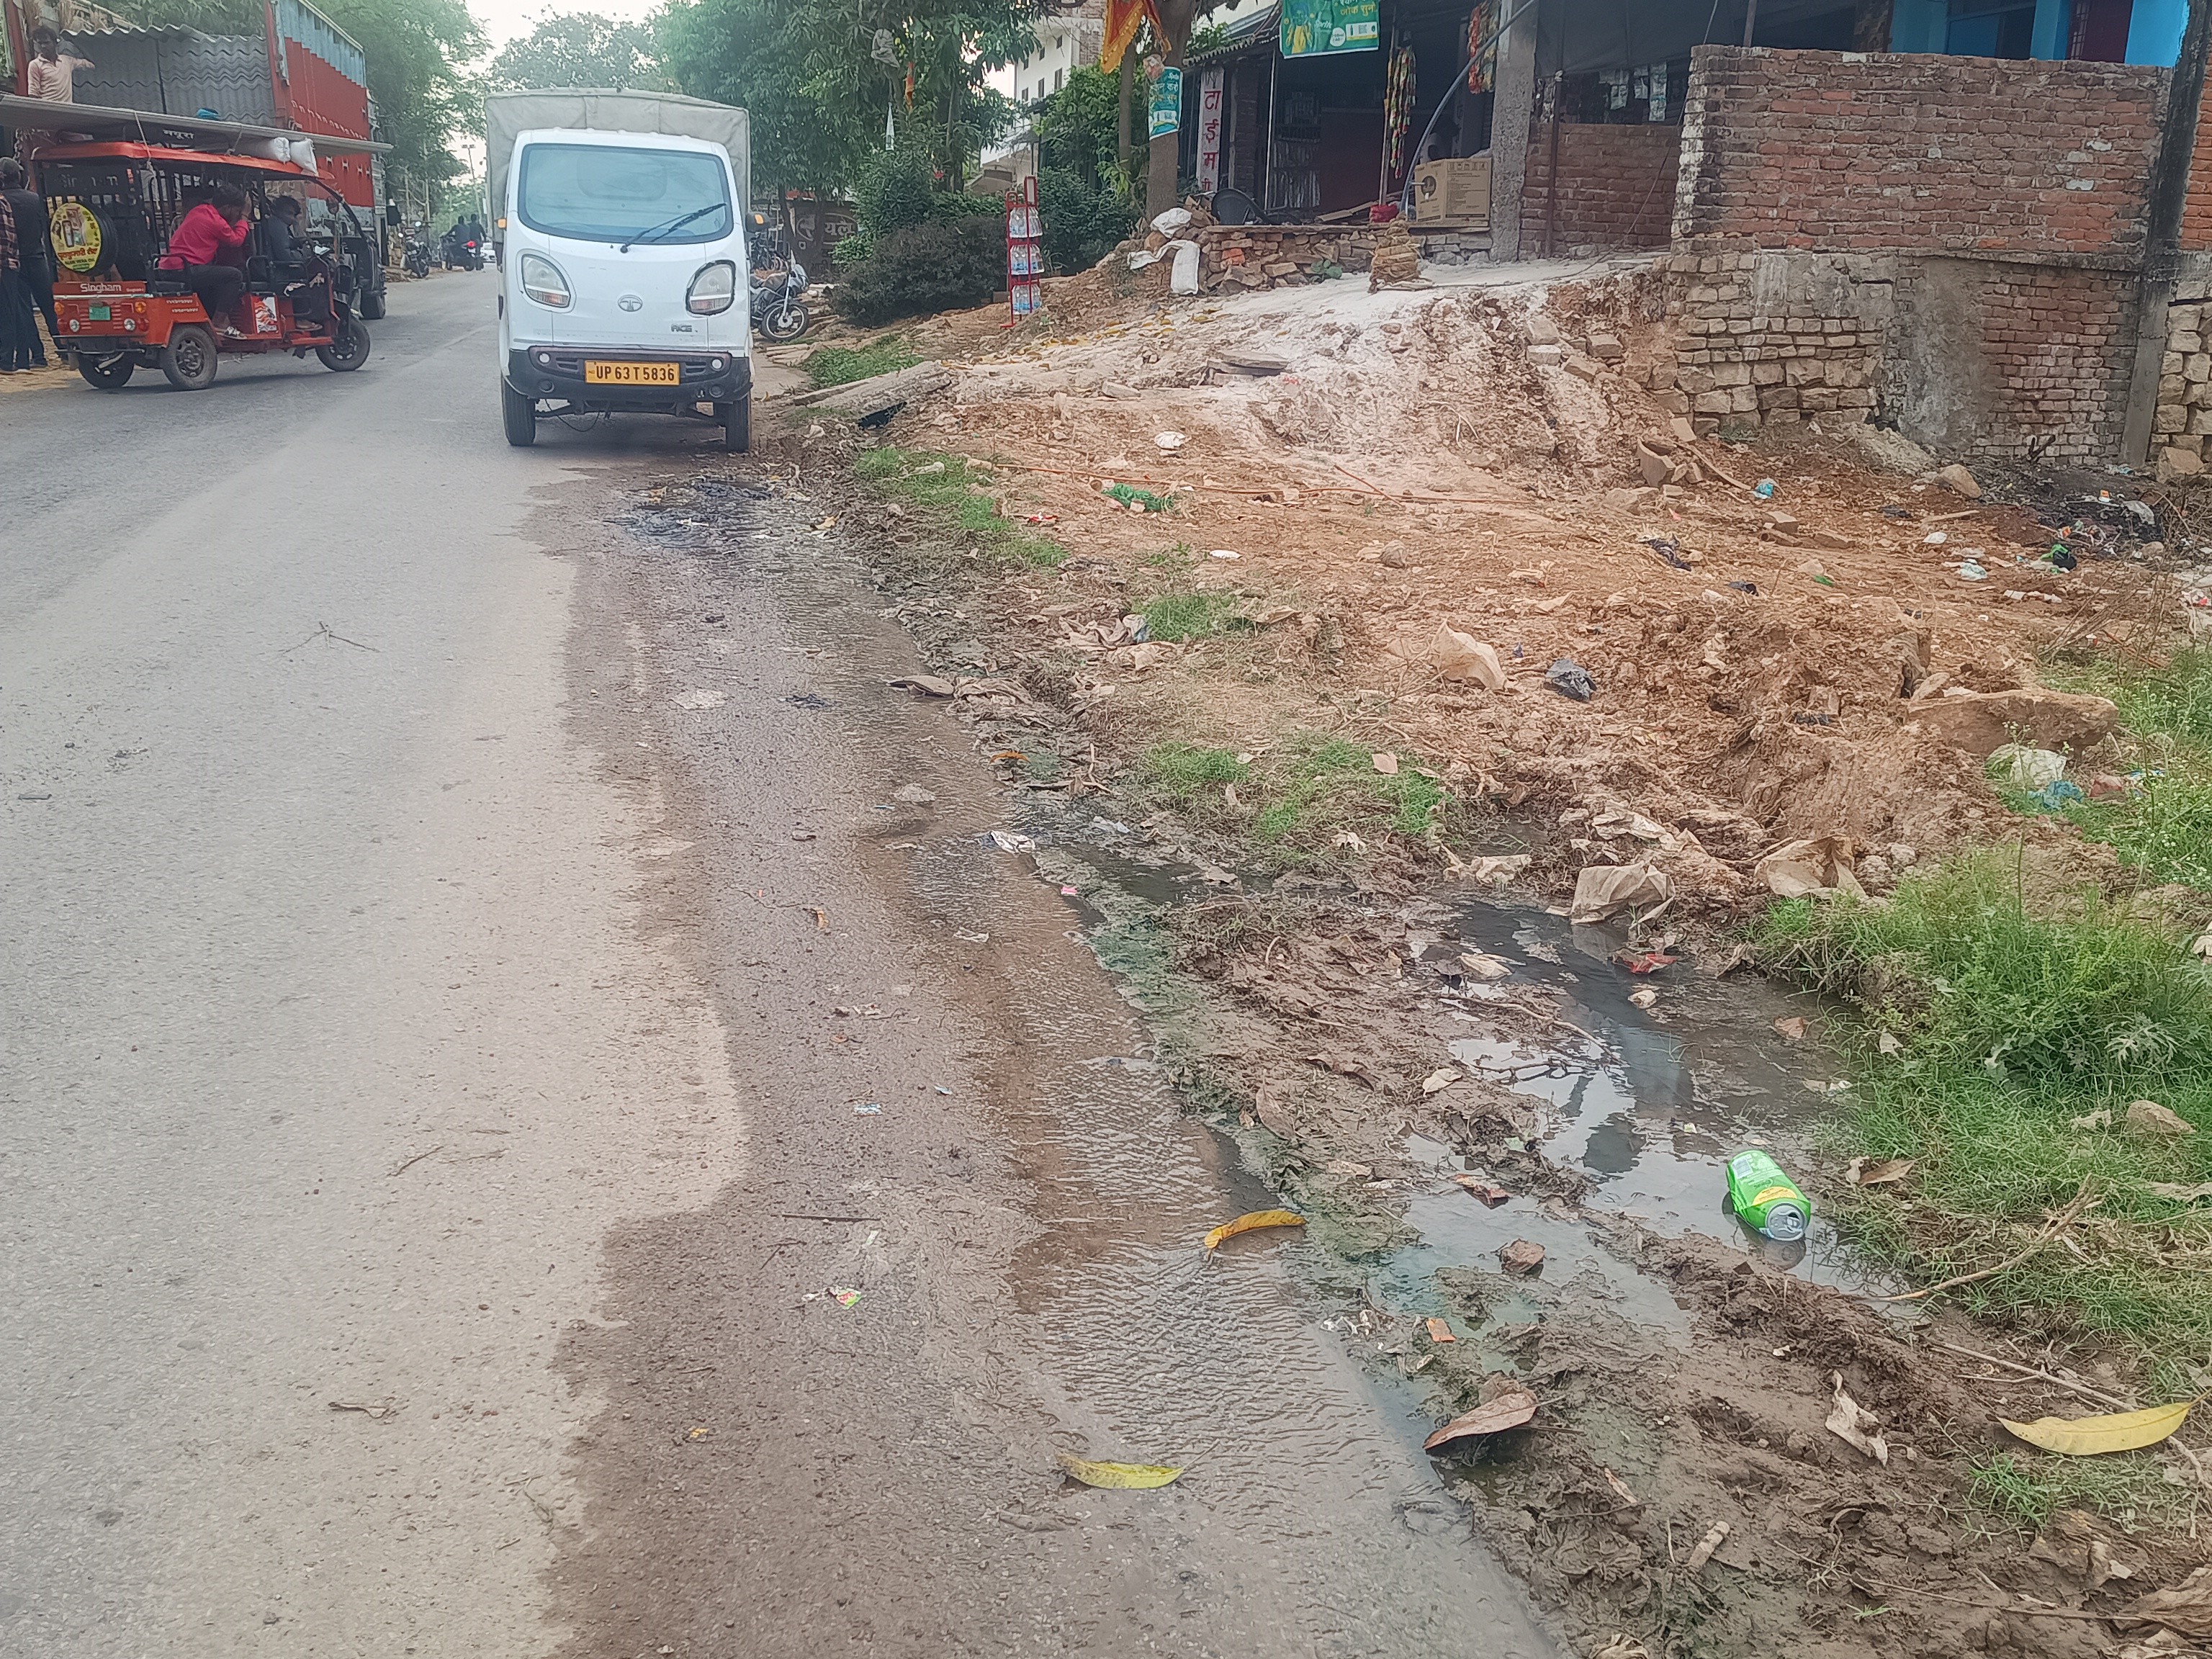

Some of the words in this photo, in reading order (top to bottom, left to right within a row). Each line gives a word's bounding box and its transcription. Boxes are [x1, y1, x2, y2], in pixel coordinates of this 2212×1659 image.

[80, 283, 122, 293] Singham
[596, 366, 611, 379] UP
[615, 367, 630, 379] 63
[633, 367, 640, 380] T
[643, 367, 675, 381] 5836
